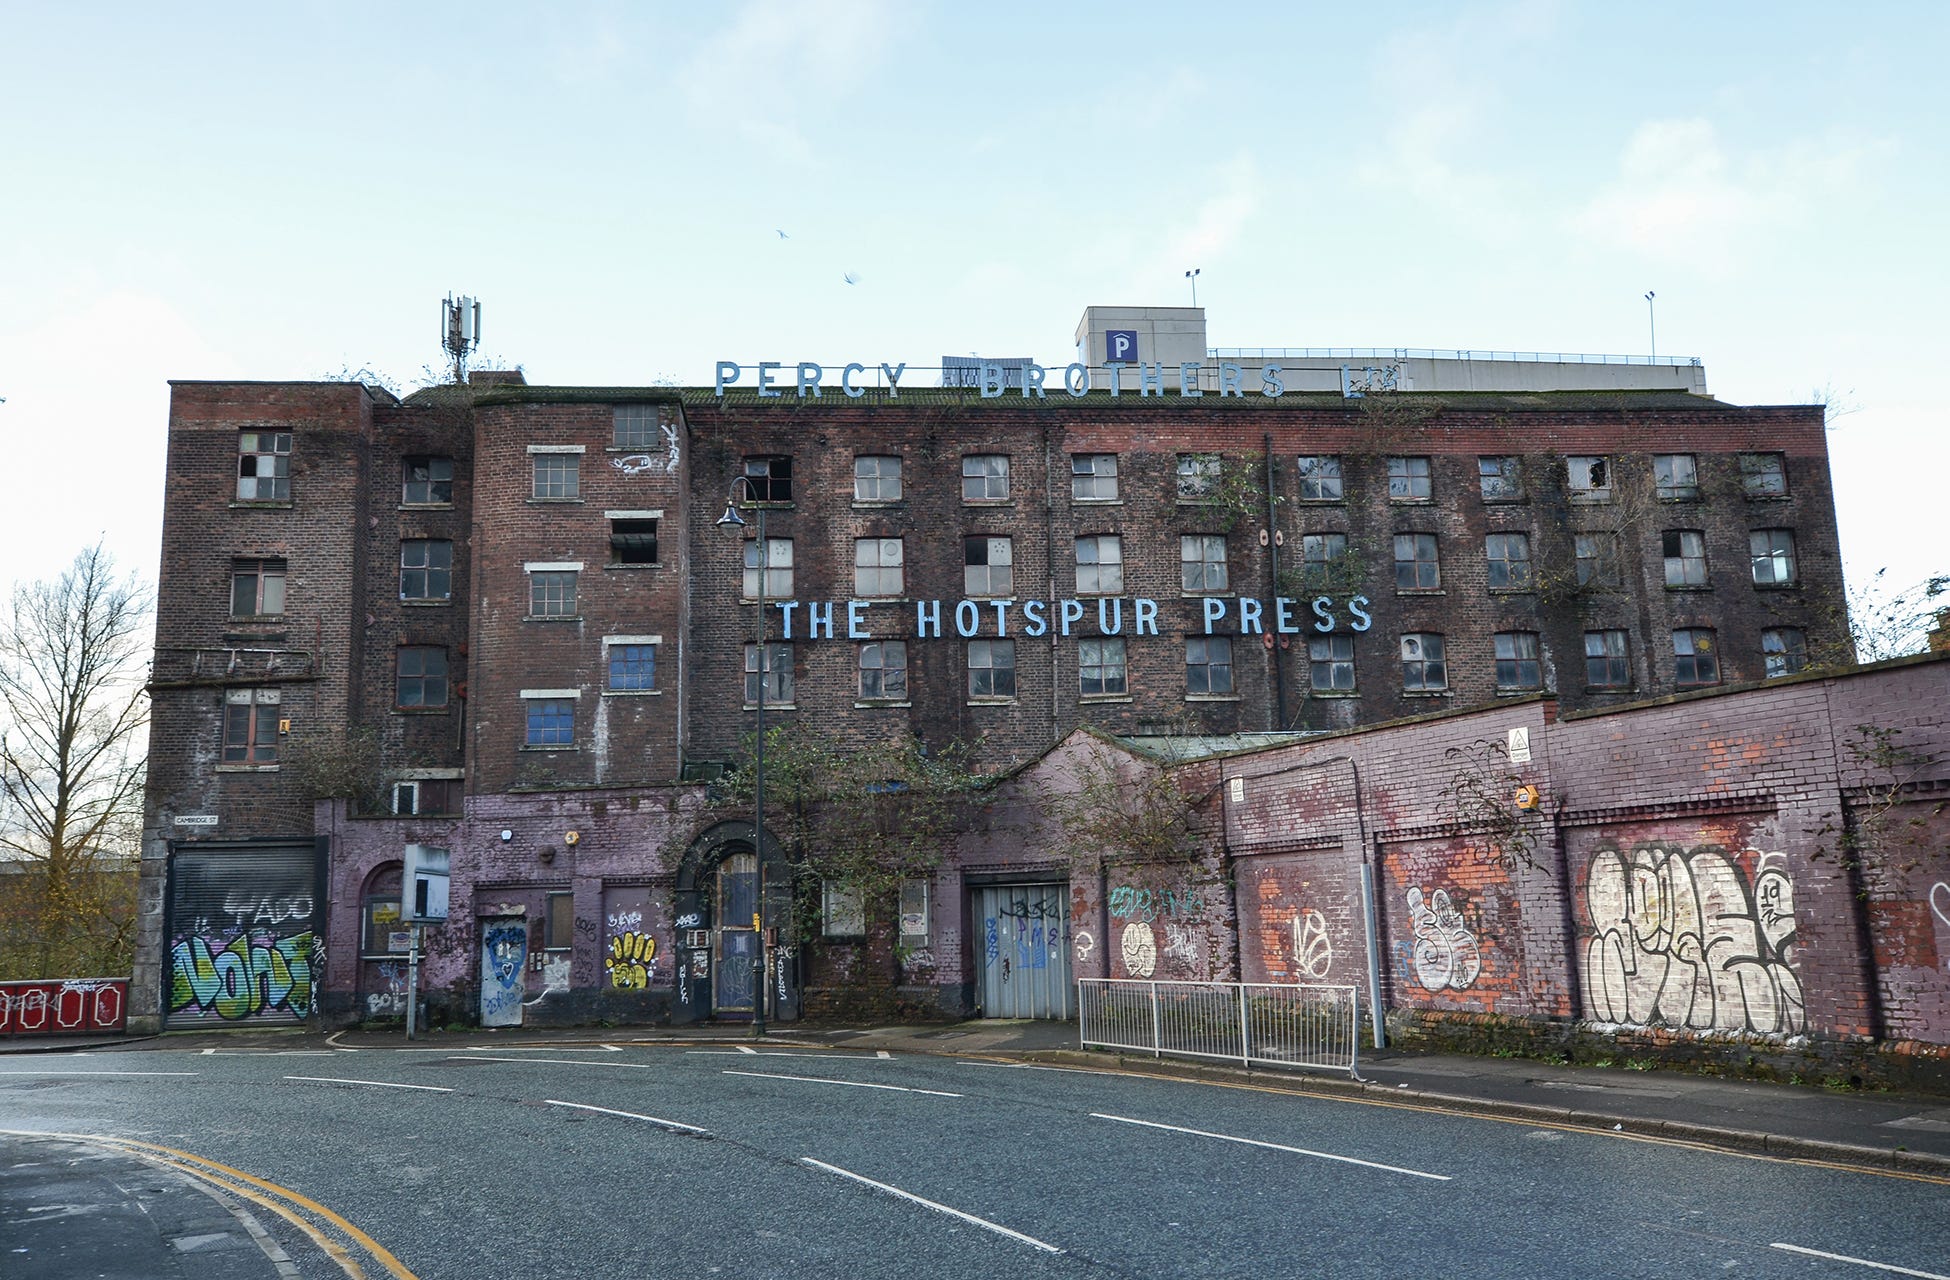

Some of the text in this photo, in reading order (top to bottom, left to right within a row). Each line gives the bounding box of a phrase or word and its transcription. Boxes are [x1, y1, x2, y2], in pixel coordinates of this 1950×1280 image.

[1115, 337, 1130, 359] P
[715, 361, 906, 398] PERCY
[980, 362, 1285, 399] BROTHERS
[776, 596, 1373, 639] THE HOTSPUR PRESS
